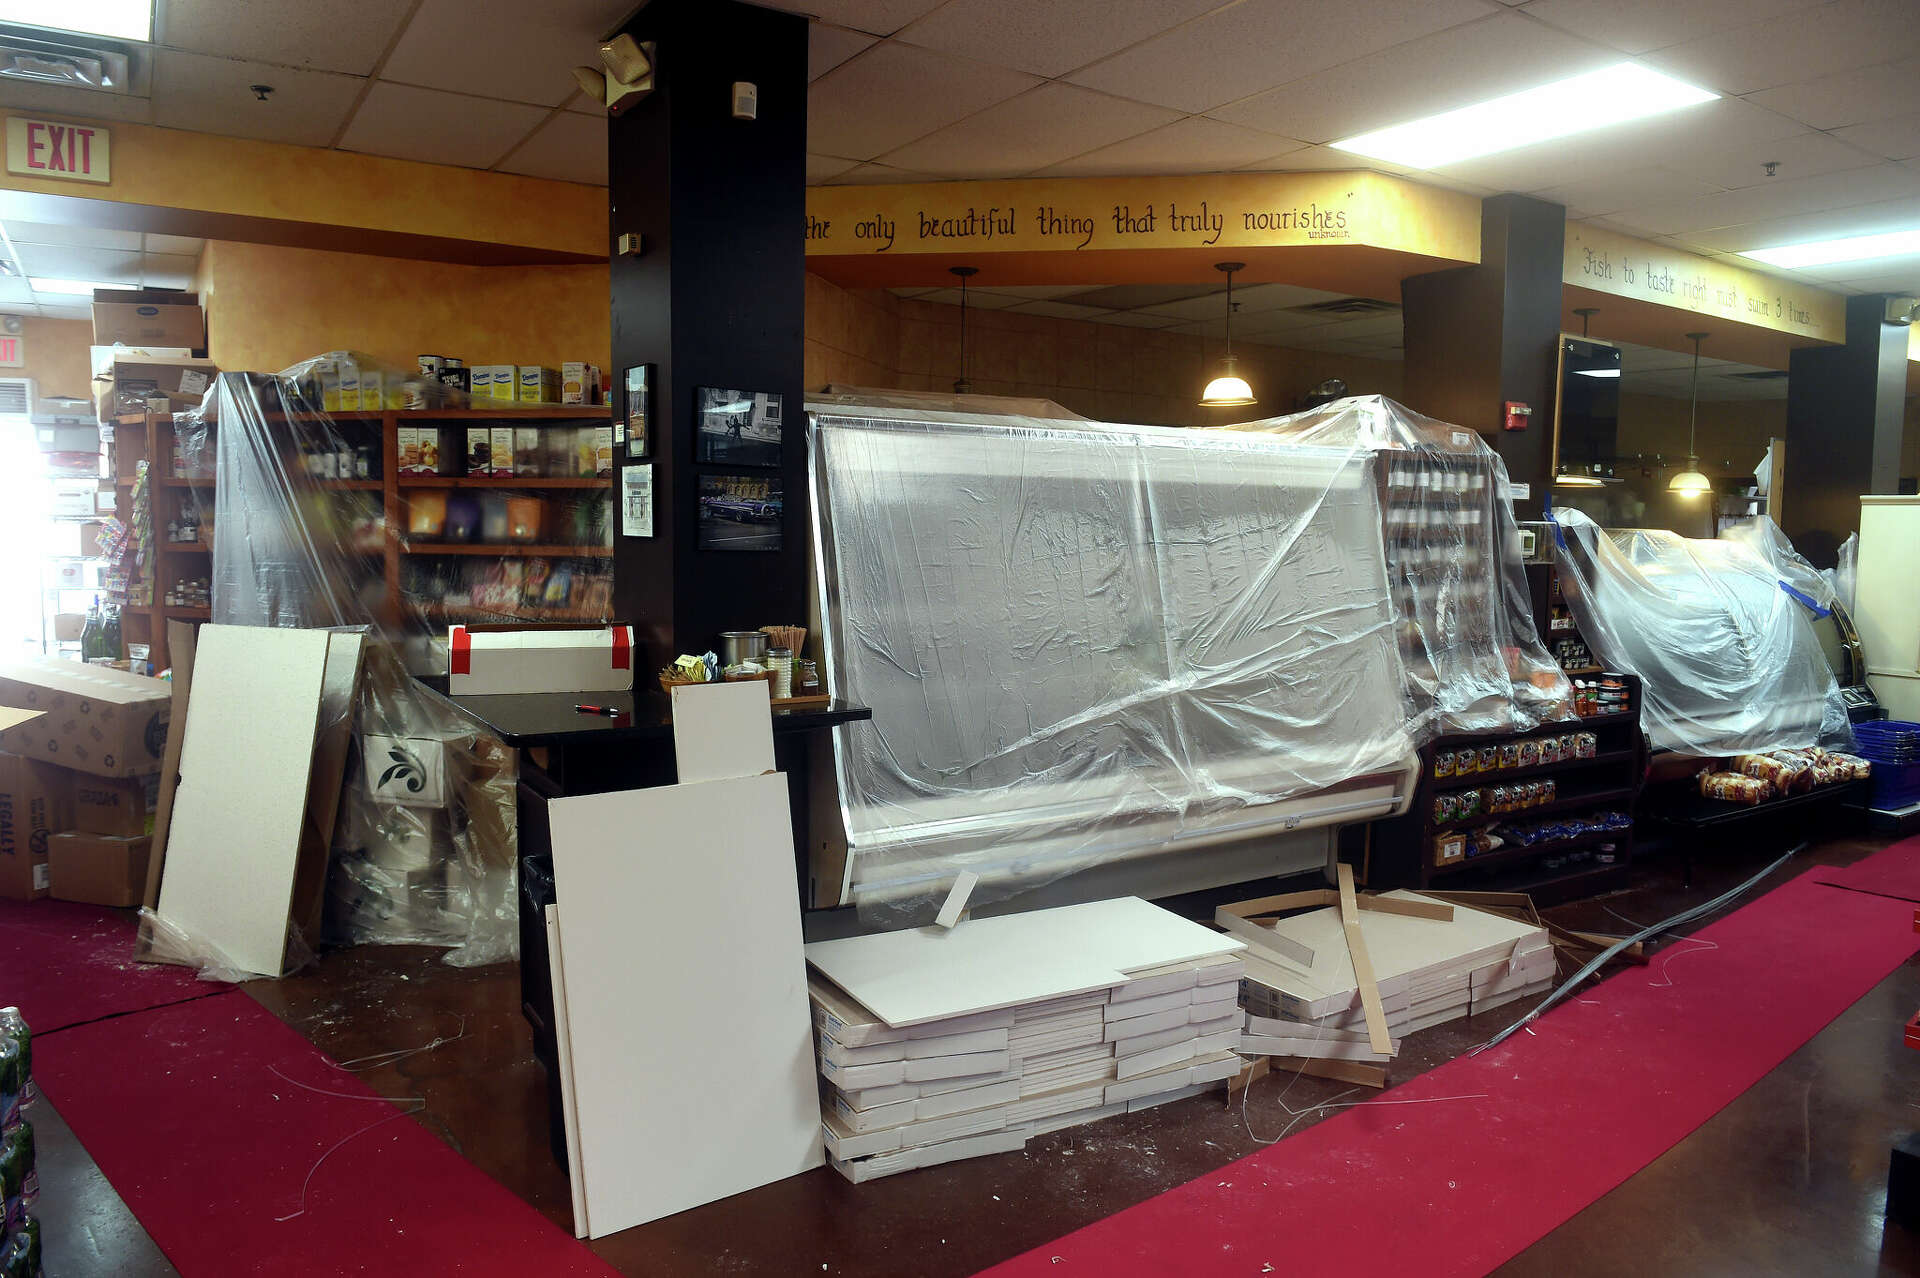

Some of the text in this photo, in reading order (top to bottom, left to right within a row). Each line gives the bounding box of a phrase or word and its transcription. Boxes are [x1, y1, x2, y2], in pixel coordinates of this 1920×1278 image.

[27, 122, 95, 174] EXIT
[805, 215, 831, 239] the
[855, 214, 895, 252] only
[918, 207, 1016, 241] beautiful
[1036, 206, 1094, 251] thing
[1112, 204, 1157, 233] that
[1168, 201, 1223, 245] truly
[1624, 257, 1635, 284] to
[1646, 262, 1675, 294] taste
[1776, 296, 1782, 318] 3
[0, 793, 15, 855] LEGALLY
